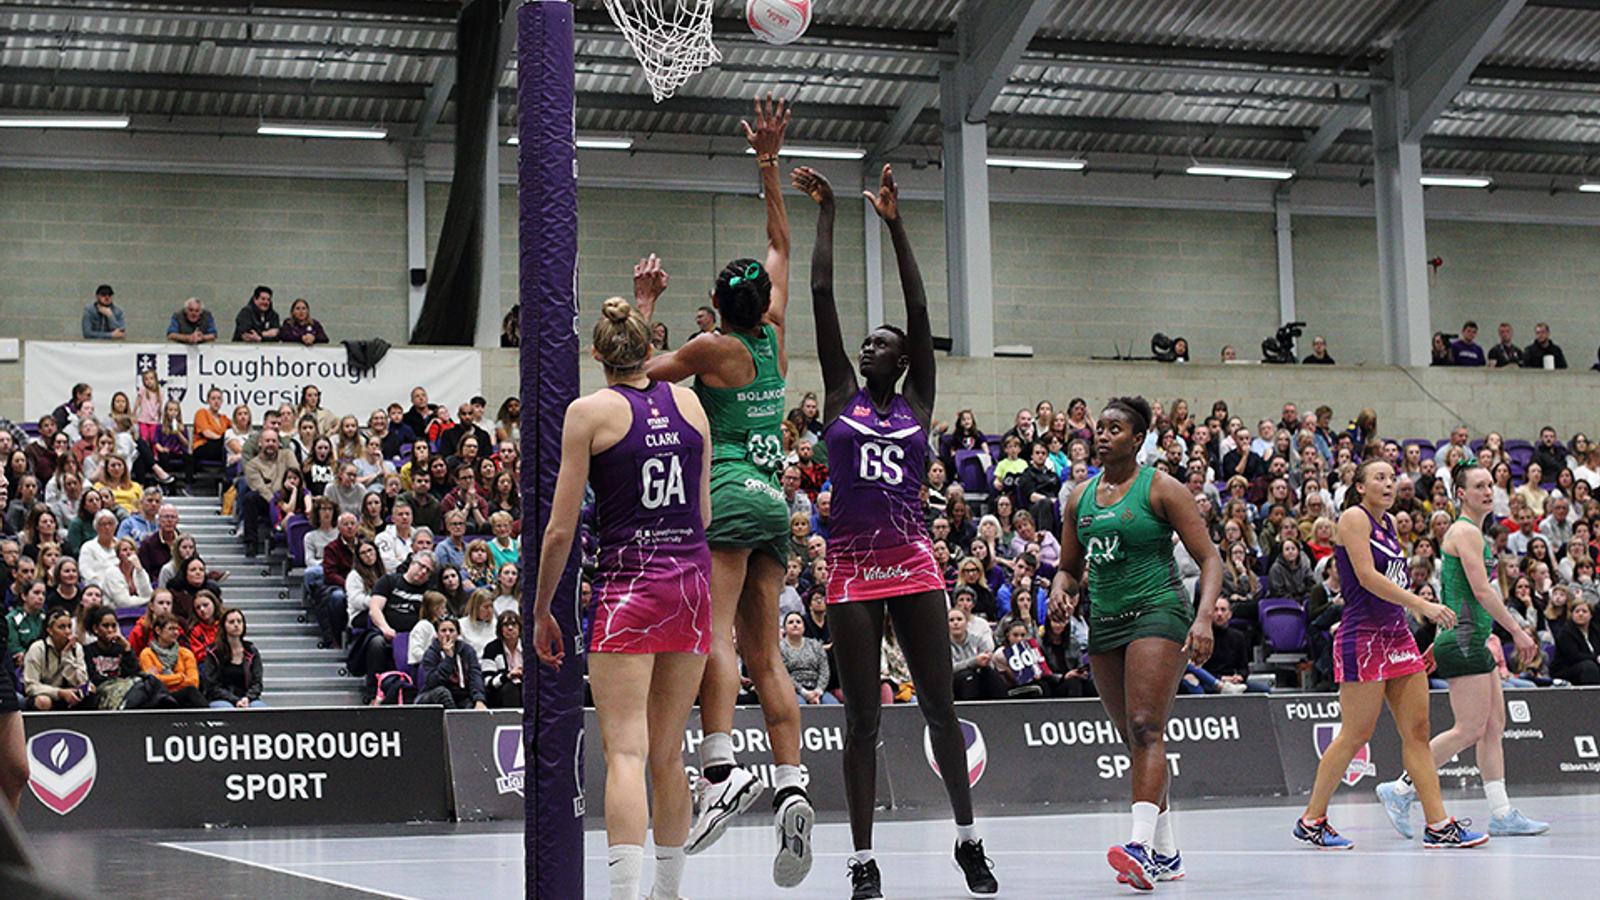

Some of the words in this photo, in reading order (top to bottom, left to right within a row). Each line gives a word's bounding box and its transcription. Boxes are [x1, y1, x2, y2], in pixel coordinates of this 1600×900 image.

[645, 431, 681, 447] CLARK
[860, 442, 904, 485] GS
[641, 455, 686, 509] GA
[1024, 716, 1240, 746] LOUGHOUGH
[145, 732, 401, 763] LOUGHBOROUGH
[1097, 753, 1181, 778] SPT
[225, 773, 327, 801] SPORT
